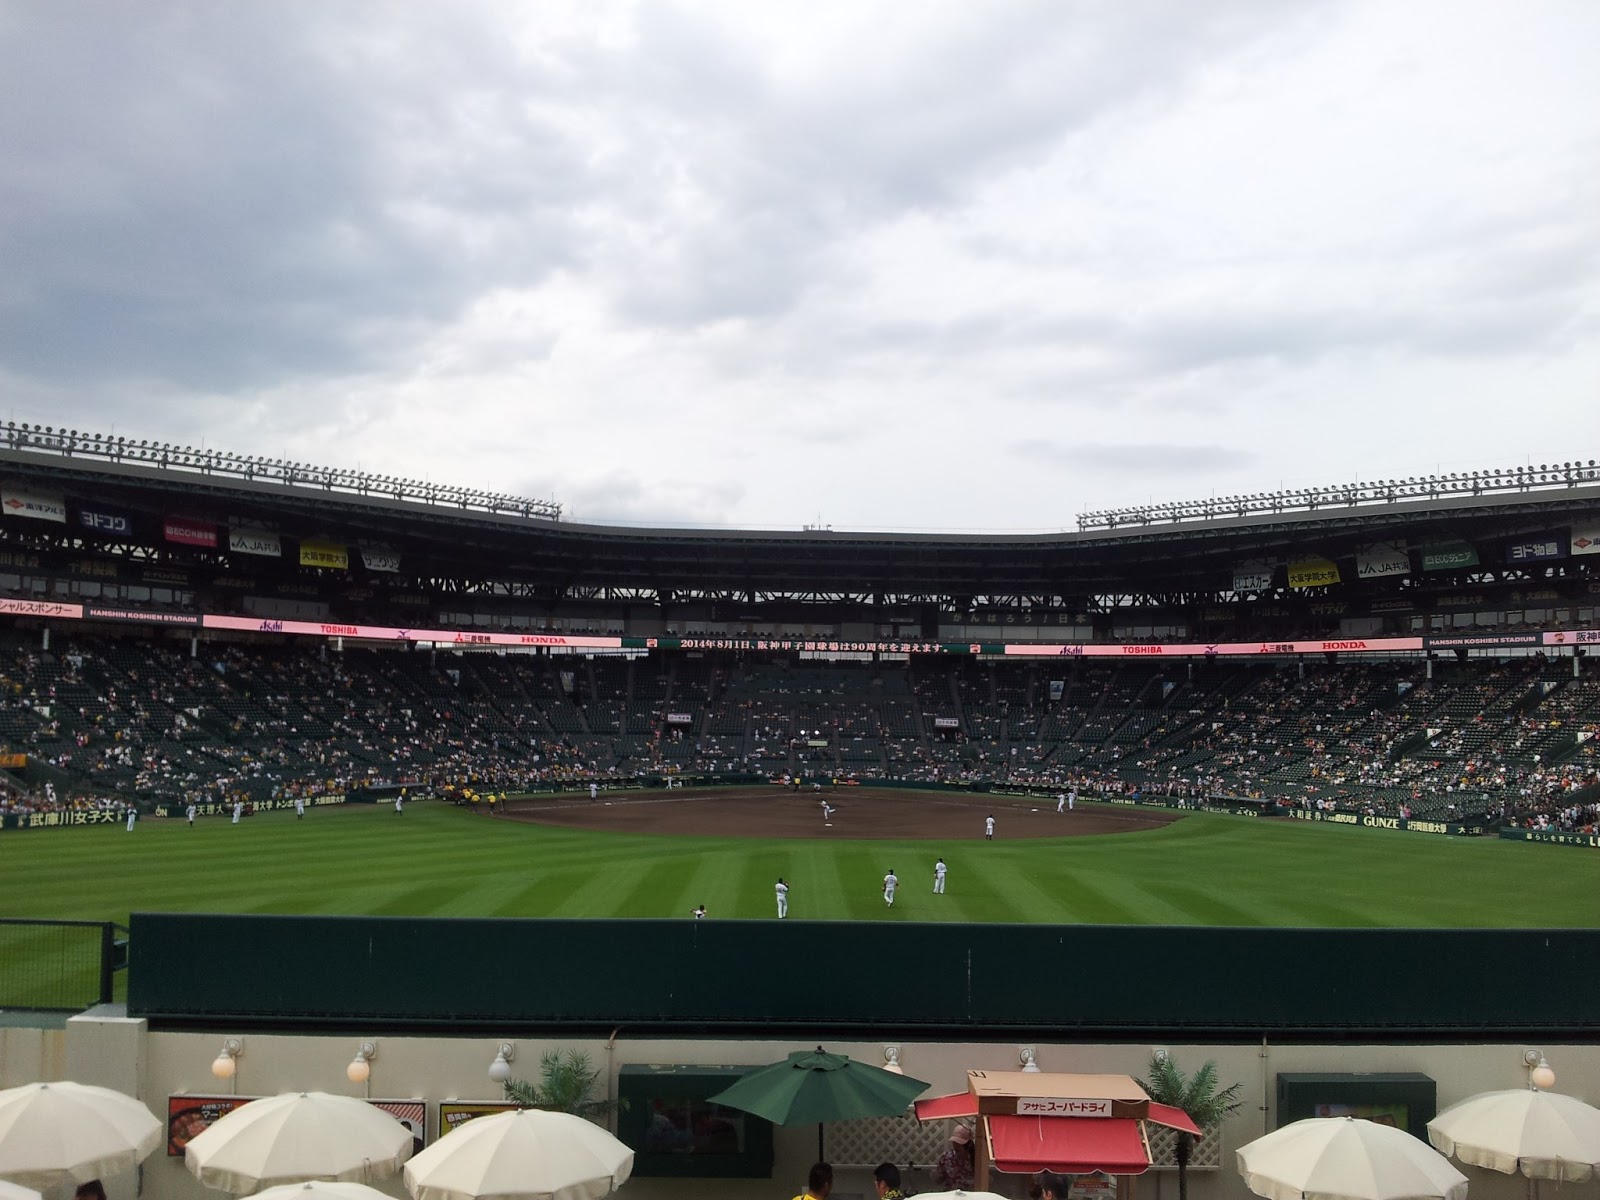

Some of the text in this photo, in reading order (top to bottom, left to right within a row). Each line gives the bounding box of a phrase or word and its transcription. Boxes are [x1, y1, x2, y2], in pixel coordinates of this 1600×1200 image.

[81, 511, 126, 531] ヨドコウ
[1290, 571, 1338, 583] 大阪学院大学
[90, 609, 197, 623] HANSHIN KOSHIEN STADIUM
[260, 620, 283, 632] Asahi
[320, 625, 358, 635] TOSHIBA
[464, 634, 491, 643] 三菱電機
[521, 636, 567, 645] HONDA
[1576, 631, 1600, 643] 阪神
[1122, 646, 1162, 654] TOSHIBA
[1269, 644, 1295, 653] 三菱電機
[1322, 641, 1367, 650] HONDA
[29, 809, 115, 827] 武庫川女子大
[1363, 816, 1400, 829] GUNZE
